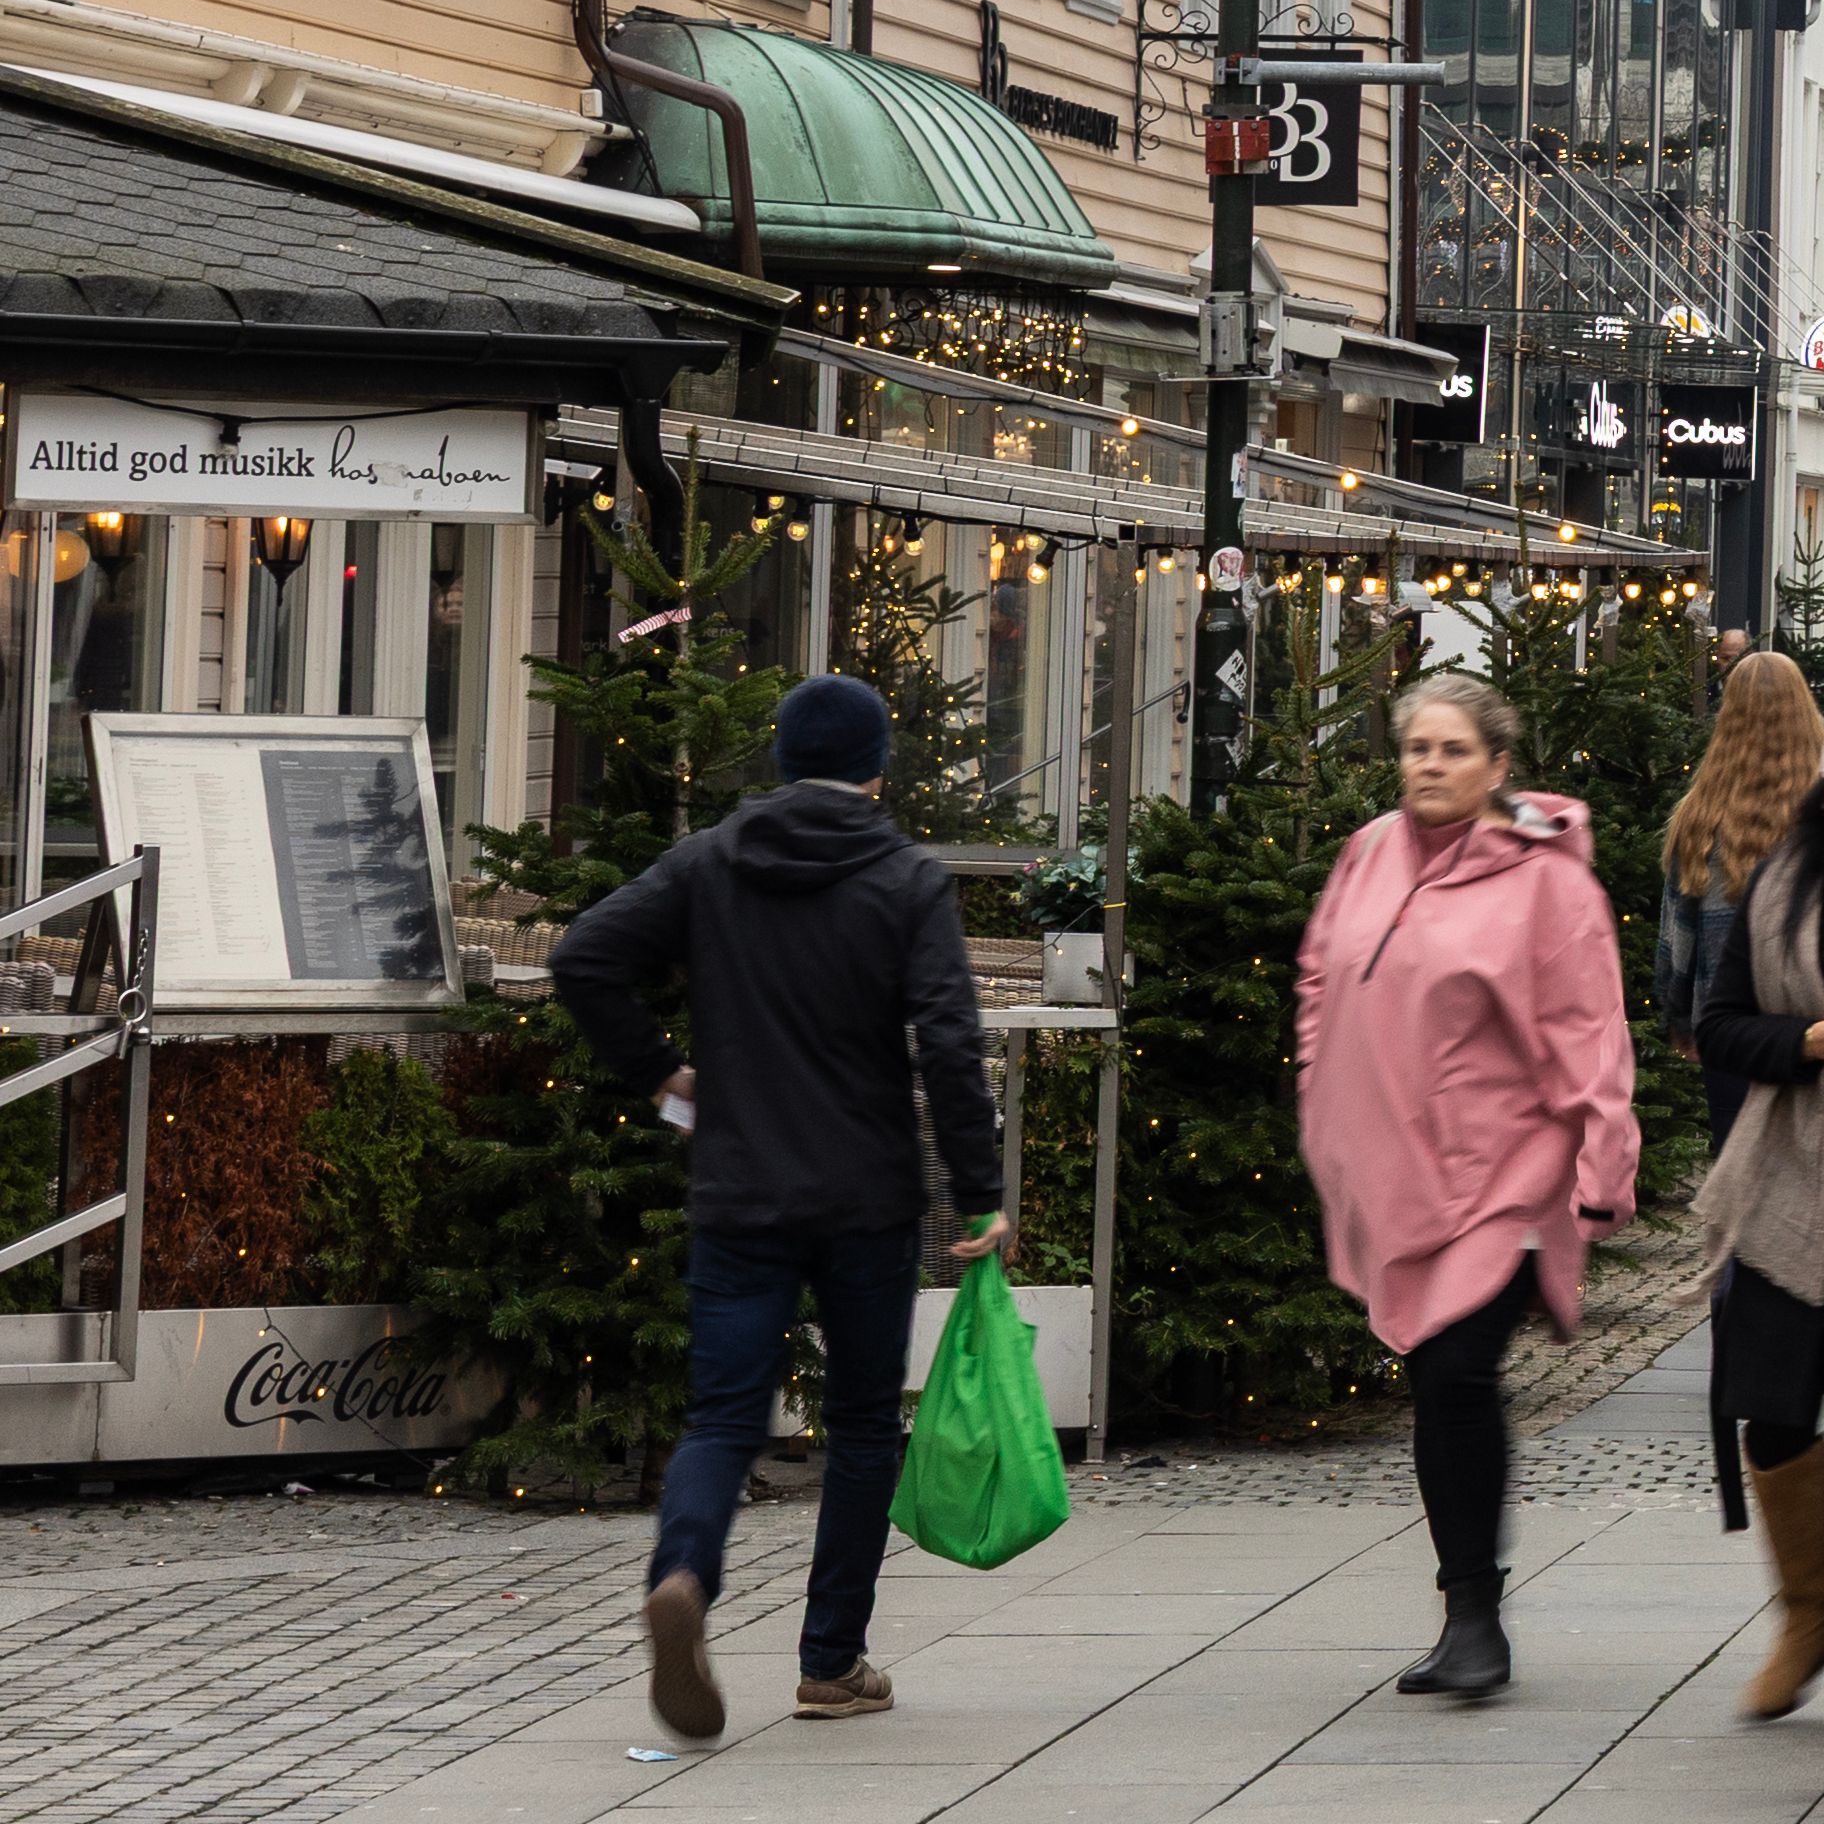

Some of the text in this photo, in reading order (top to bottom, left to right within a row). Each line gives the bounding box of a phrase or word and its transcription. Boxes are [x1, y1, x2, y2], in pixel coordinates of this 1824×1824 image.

[29, 439, 119, 474] Alltid
[128, 443, 189, 482] god
[198, 446, 315, 478] musikk
[328, 424, 378, 485] hos
[1667, 416, 1746, 445] Cubus
[224, 1335, 447, 1428] Coca-Cola
